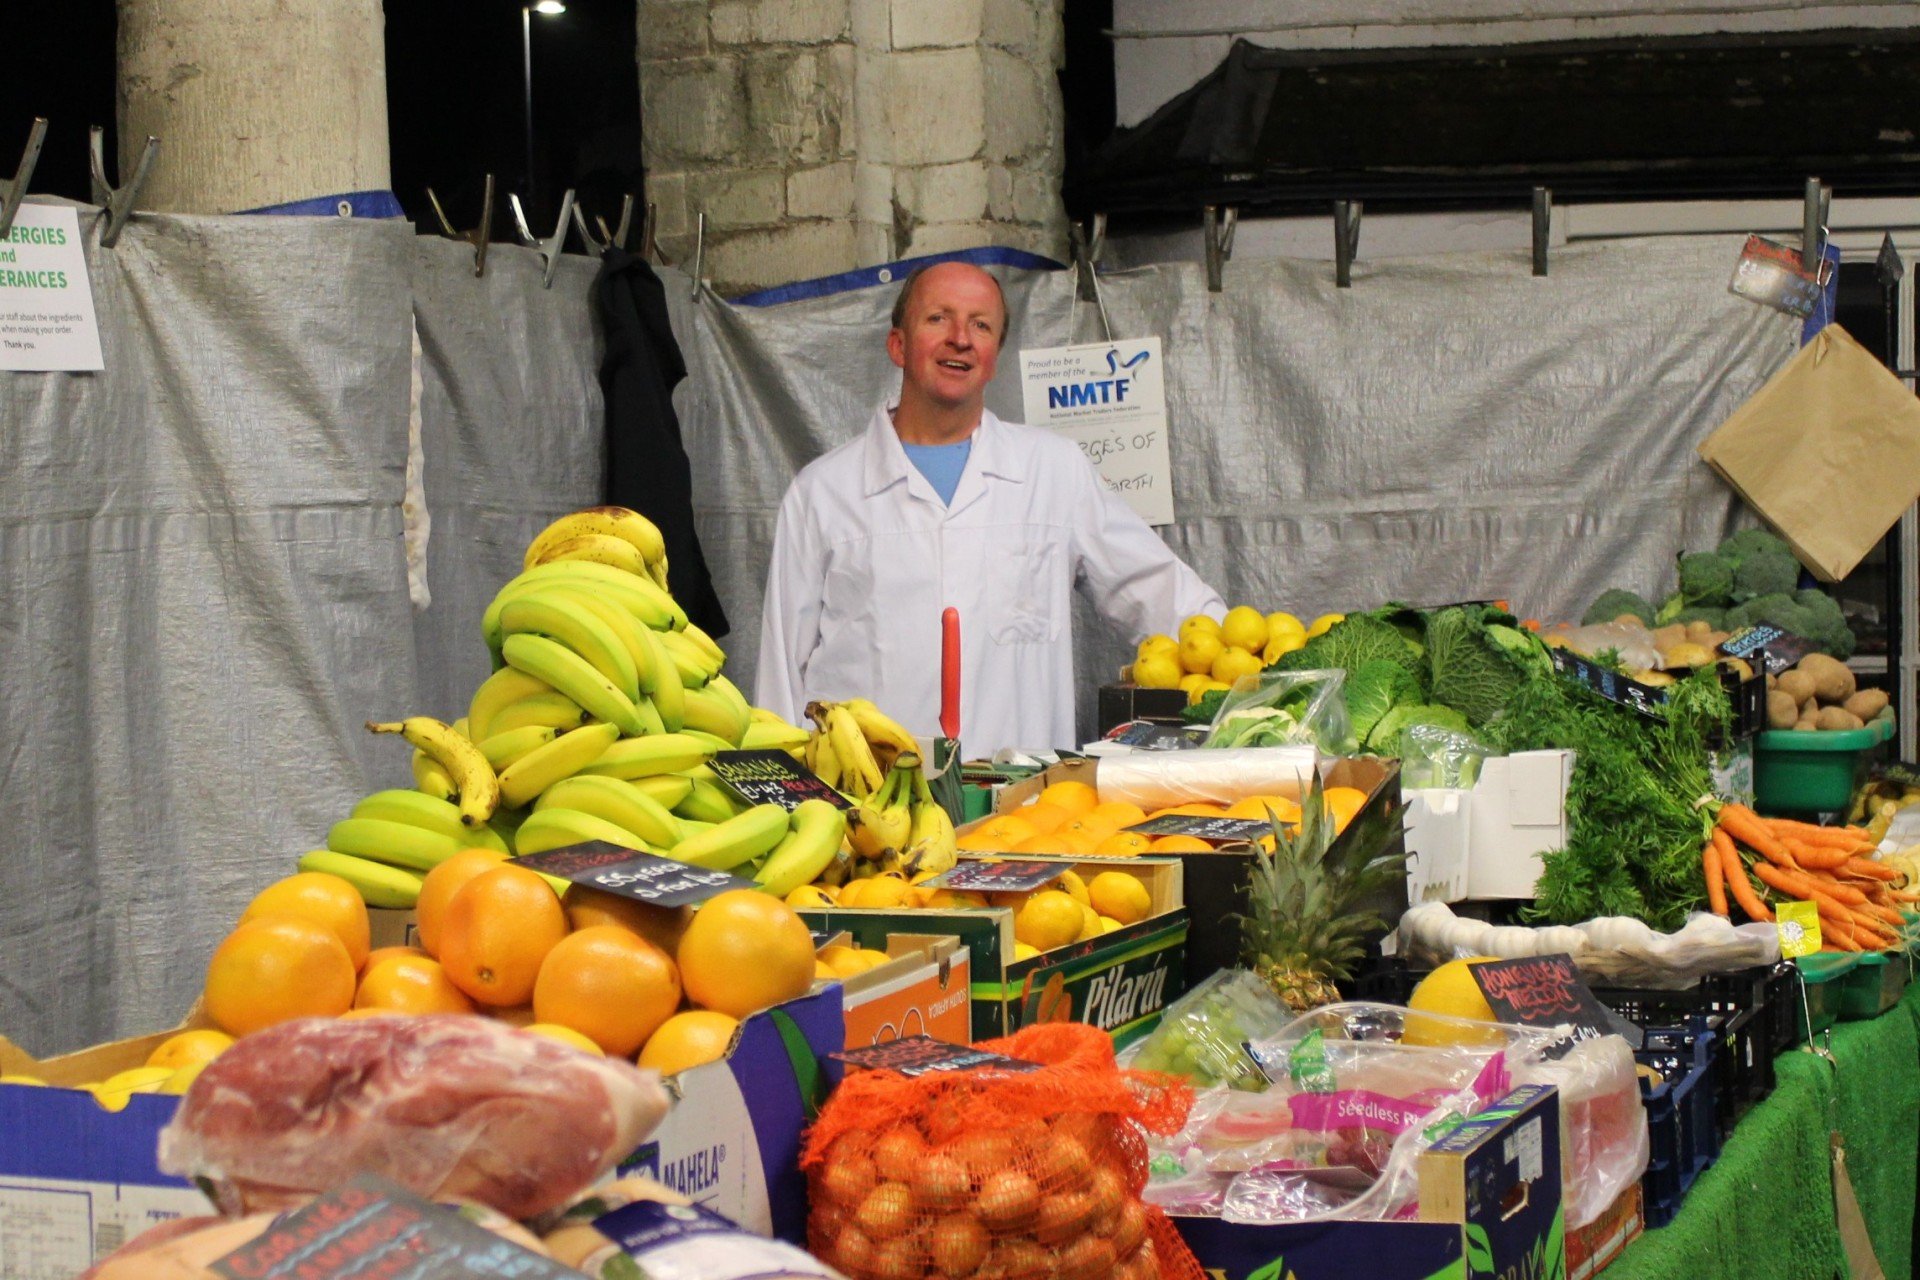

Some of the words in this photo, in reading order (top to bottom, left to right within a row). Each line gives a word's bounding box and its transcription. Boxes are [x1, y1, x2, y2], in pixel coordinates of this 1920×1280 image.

[2, 225, 66, 246] ERGIES
[0, 248, 16, 263] nd
[19, 313, 37, 321] about
[38, 313, 47, 321] the
[49, 313, 83, 323] ingredients
[1, 325, 17, 333] when
[18, 326, 40, 336] making
[41, 326, 54, 335] your
[4, 340, 22, 349] Thank
[1028, 359, 1051, 369] Proud
[1053, 358, 1061, 366] to
[1063, 357, 1073, 366] be
[1028, 370, 1061, 380] member
[1063, 368, 1071, 378] of
[1073, 368, 1086, 376] the
[1048, 378, 1130, 409] NMTF
[1132, 430, 1156, 449] OF
[1337, 1100, 1400, 1125] Seedless
